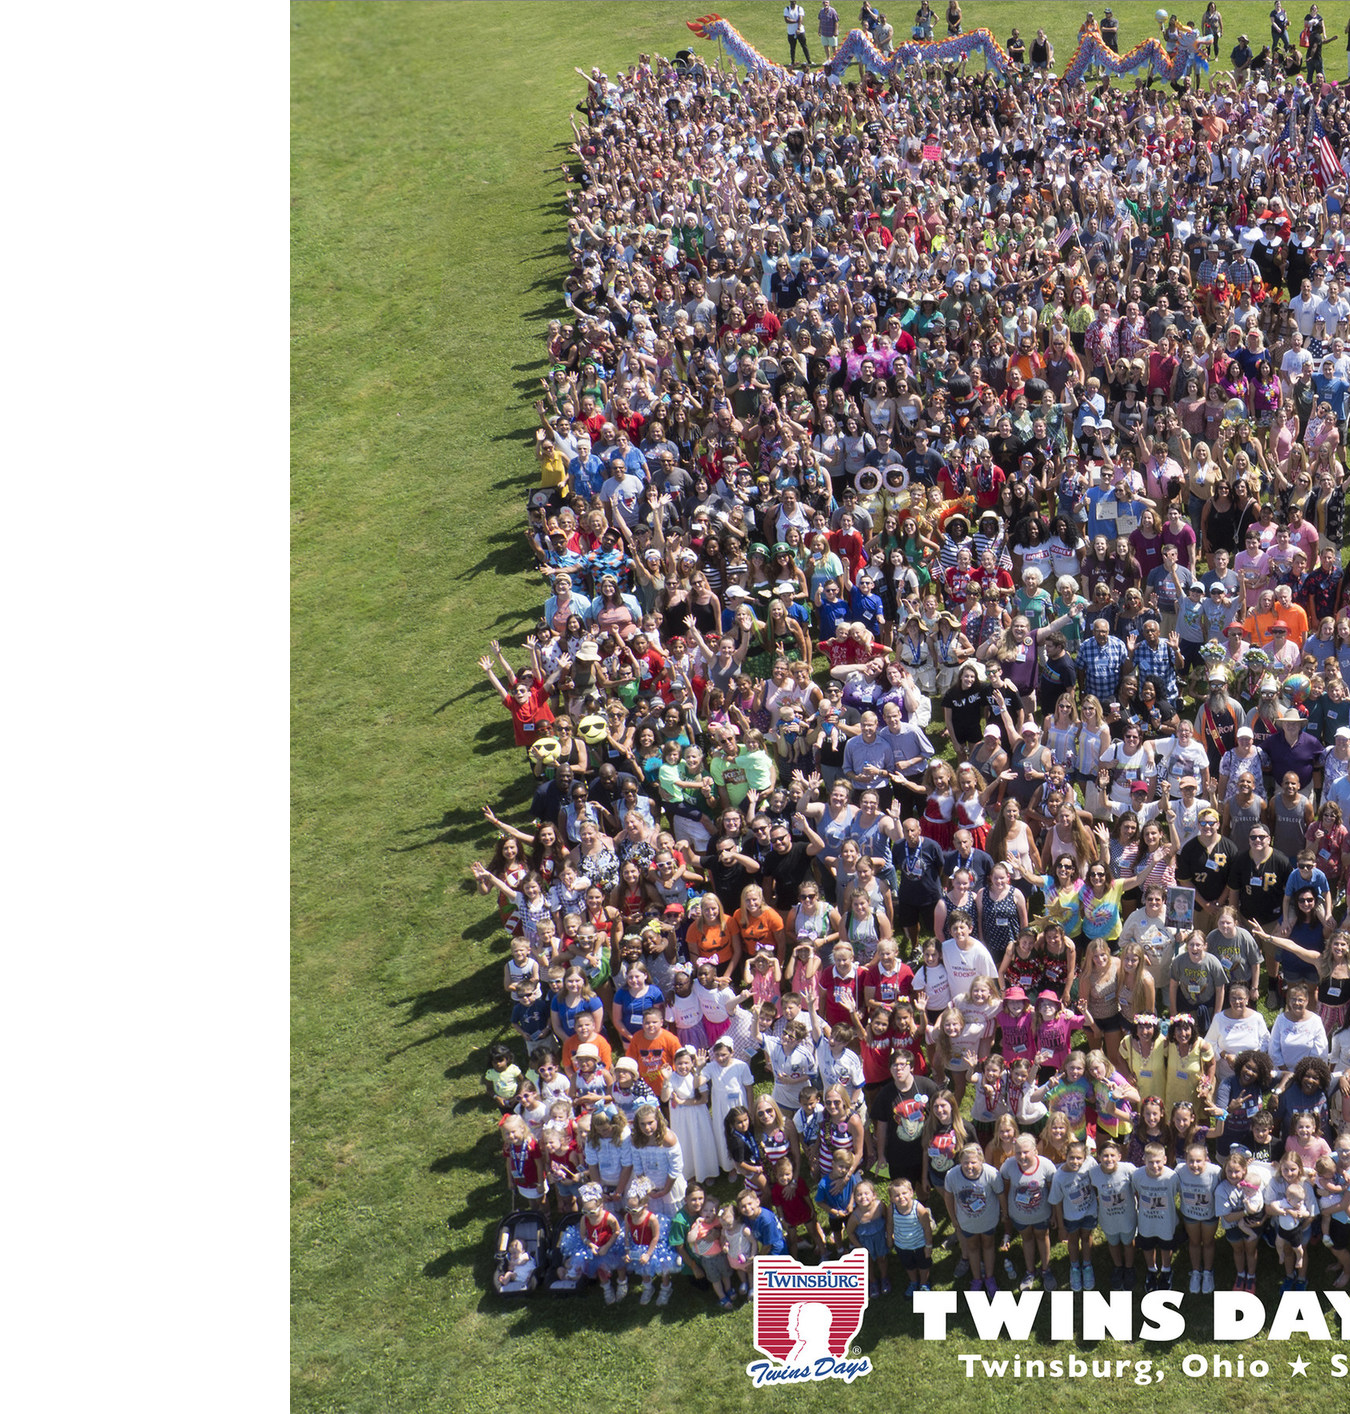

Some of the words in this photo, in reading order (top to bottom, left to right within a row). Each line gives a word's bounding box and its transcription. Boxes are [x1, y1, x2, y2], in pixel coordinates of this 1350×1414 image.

[952, 698, 966, 707] BUY
[968, 692, 981, 703] ONE
[1195, 872, 1208, 883] 27
[1184, 968, 1208, 978] SPYRO
